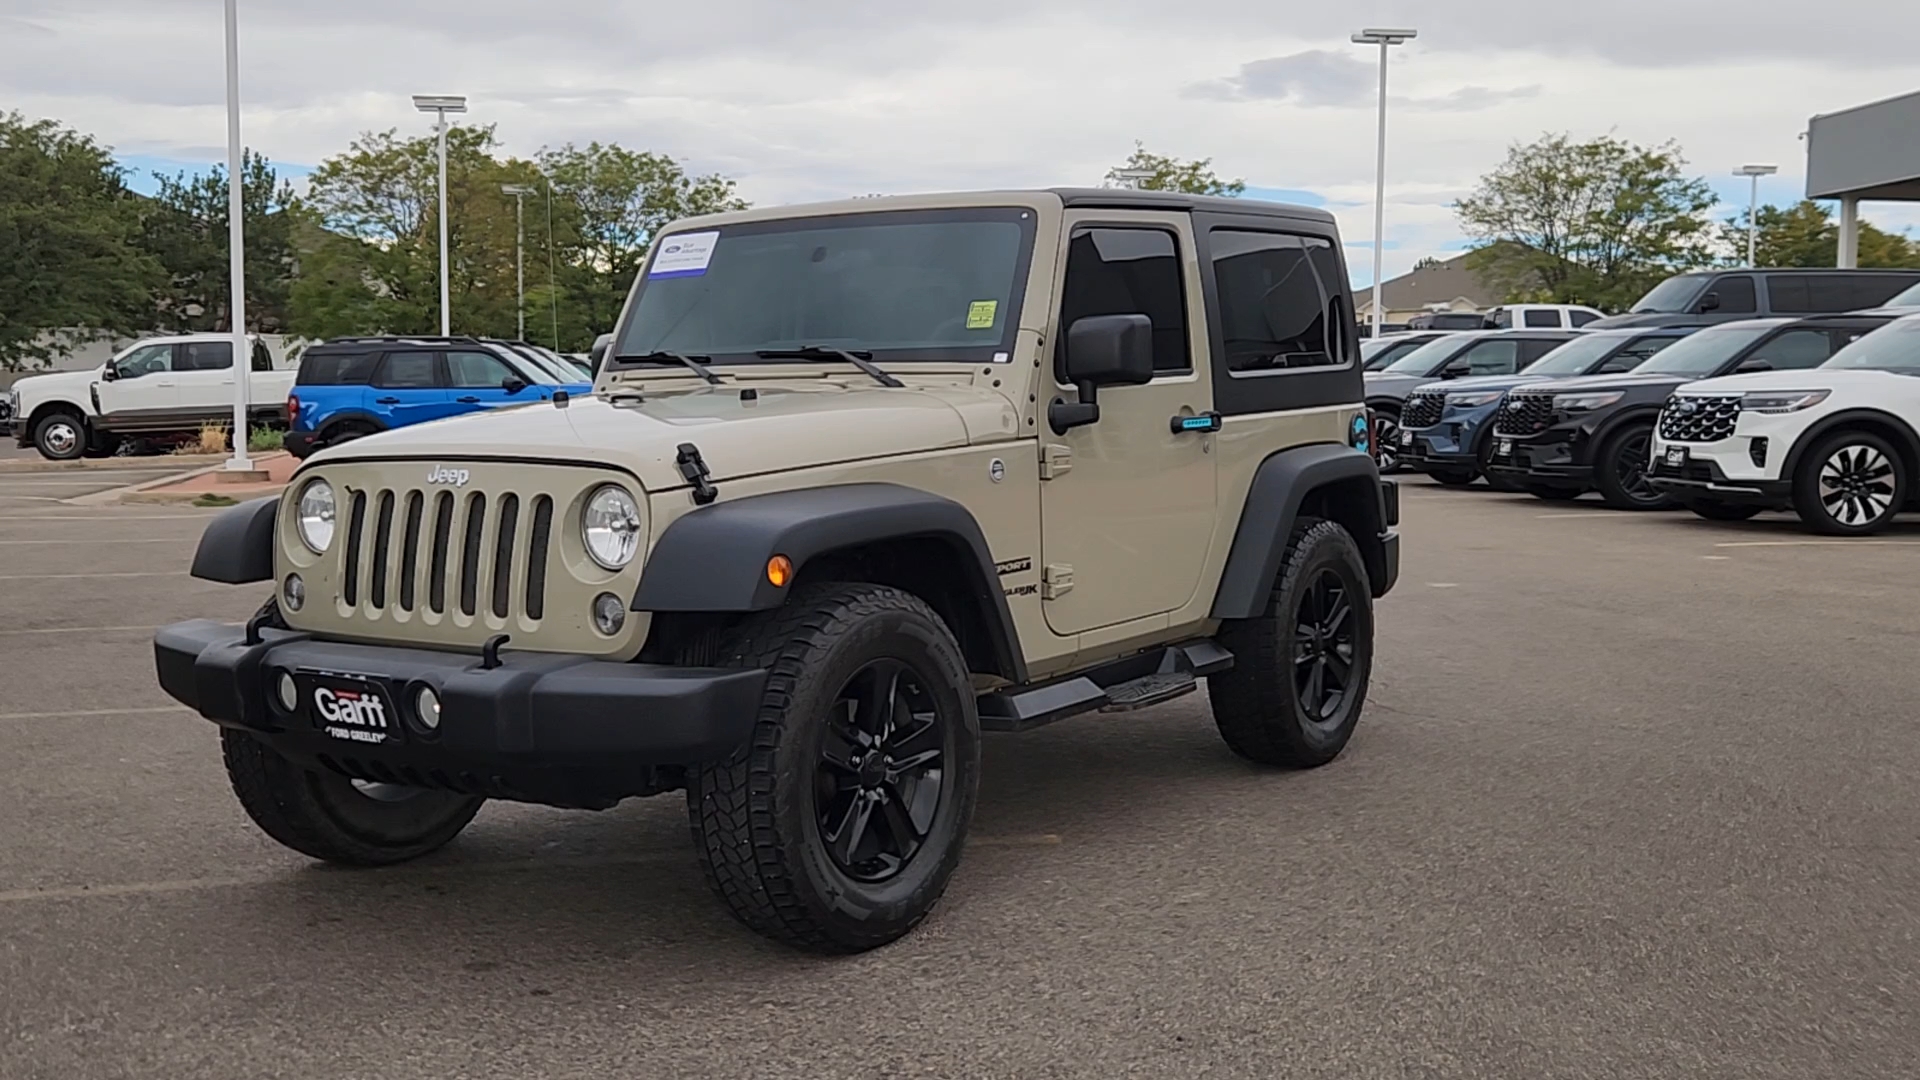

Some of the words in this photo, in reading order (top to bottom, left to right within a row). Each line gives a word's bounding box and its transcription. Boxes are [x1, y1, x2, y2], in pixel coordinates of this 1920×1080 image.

[427, 464, 470, 487] Jeep
[995, 560, 1031, 573] PORT
[314, 687, 387, 728] Garff
